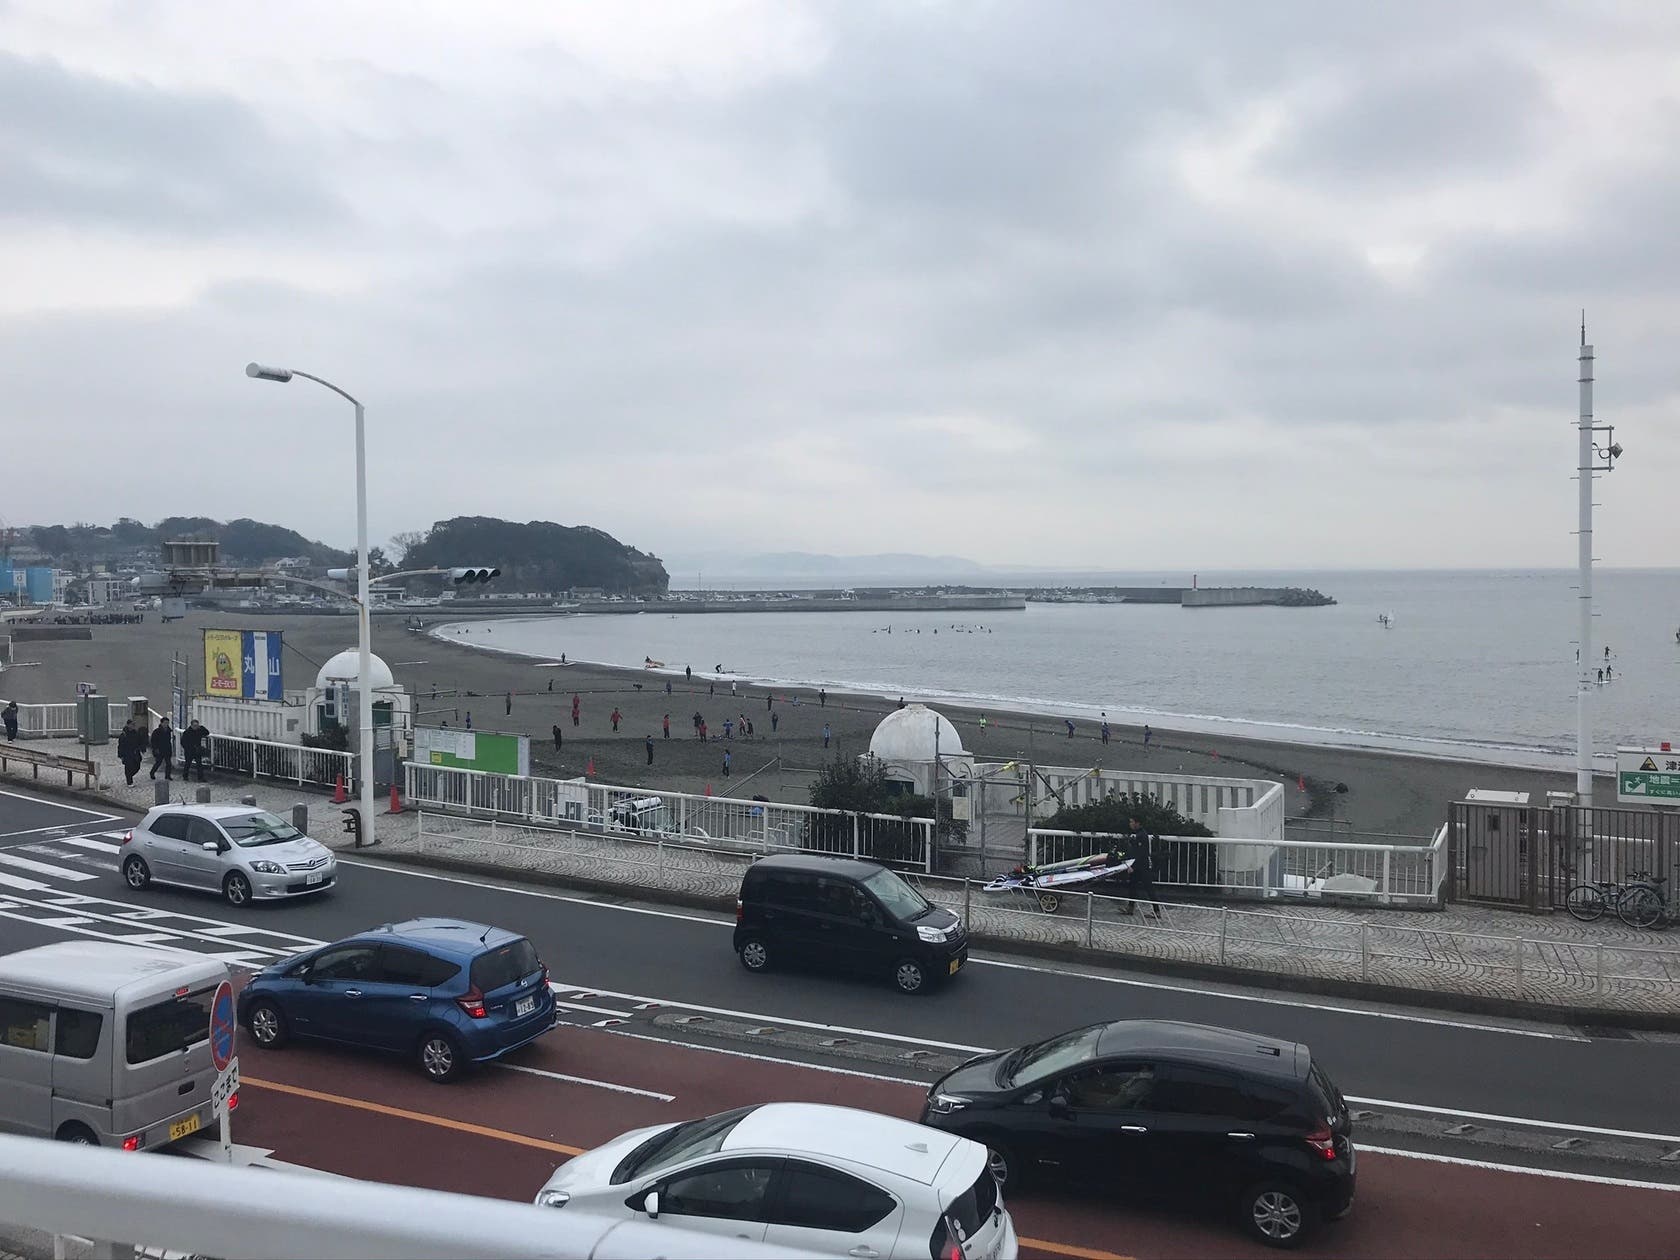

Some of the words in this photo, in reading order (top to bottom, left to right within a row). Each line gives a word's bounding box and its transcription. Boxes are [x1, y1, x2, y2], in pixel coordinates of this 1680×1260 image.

[244, 654, 255, 674] 丸
[268, 657, 280, 676] 山
[213, 1066, 238, 1109] ここまで
[175, 1120, 197, 1137] 58-11
